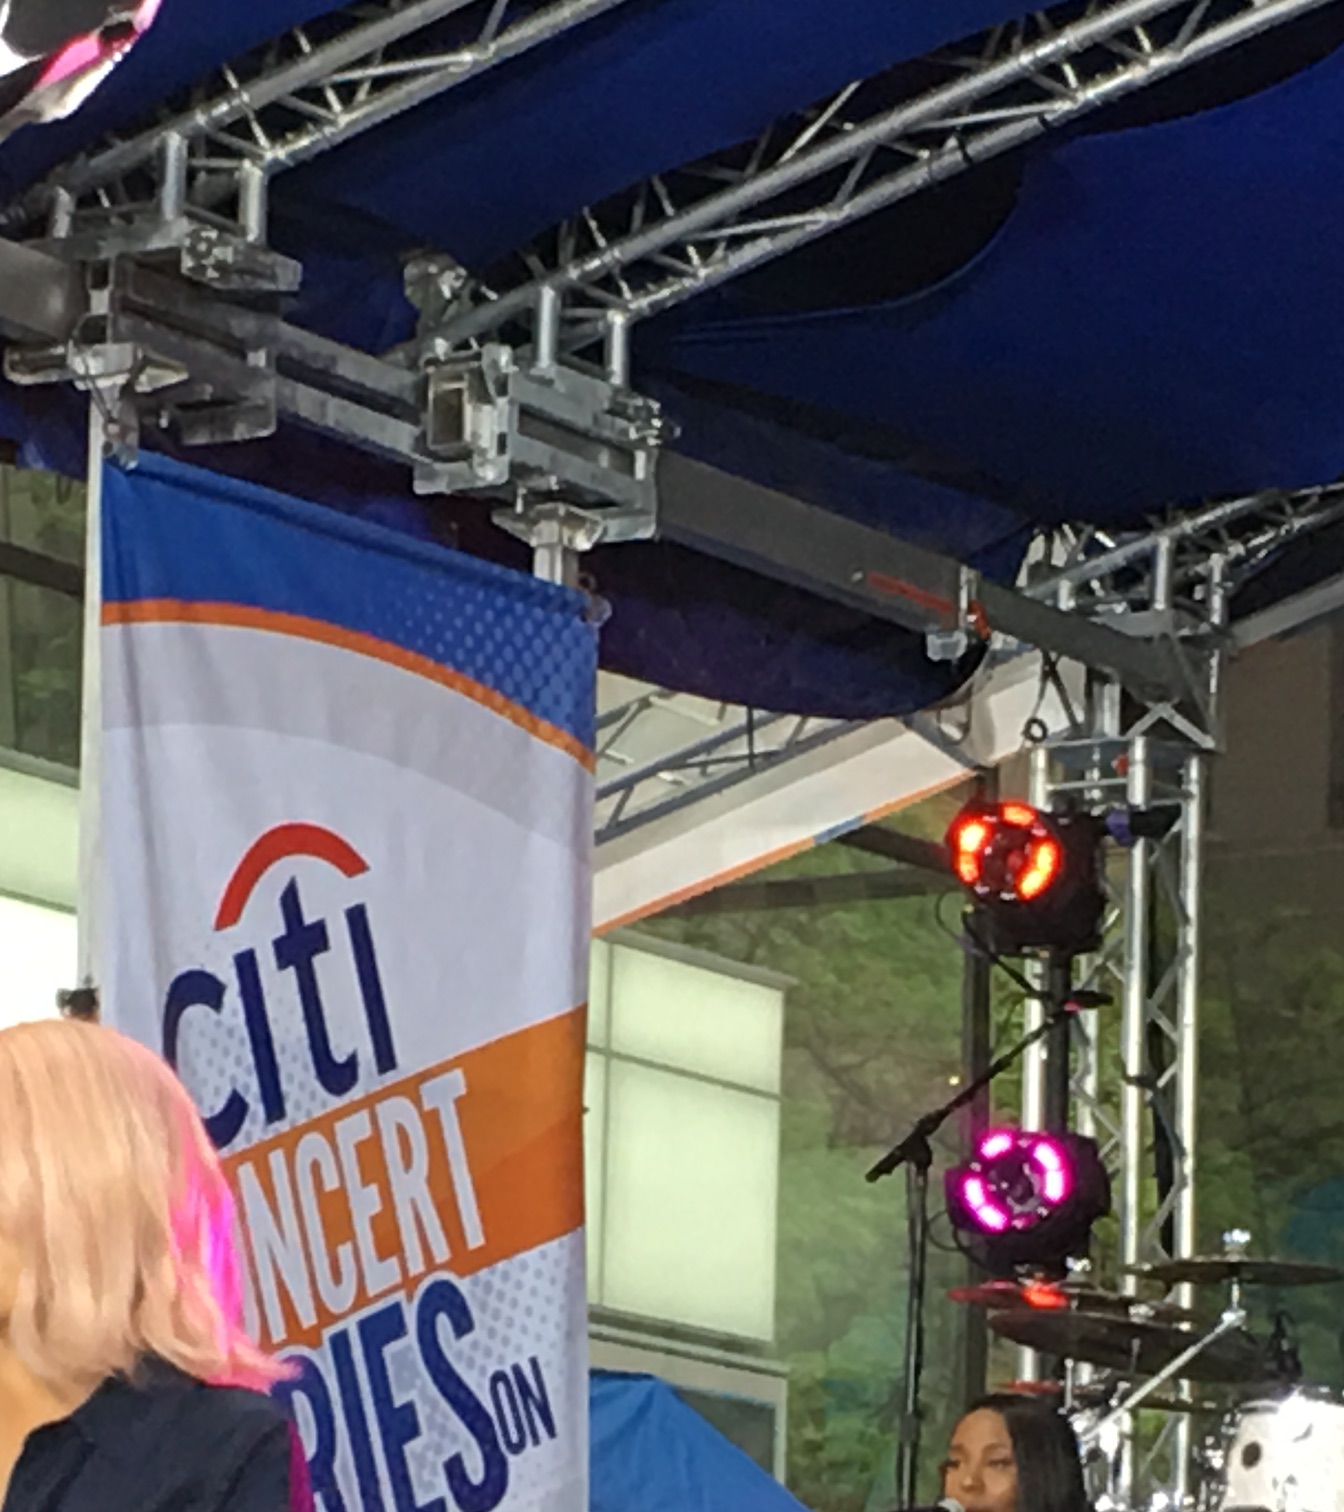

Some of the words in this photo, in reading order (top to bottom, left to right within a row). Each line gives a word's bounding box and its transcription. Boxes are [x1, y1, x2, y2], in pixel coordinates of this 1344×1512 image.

[161, 875, 398, 1149] citi
[236, 1069, 486, 1344] NCERT
[489, 1356, 558, 1456] ON
